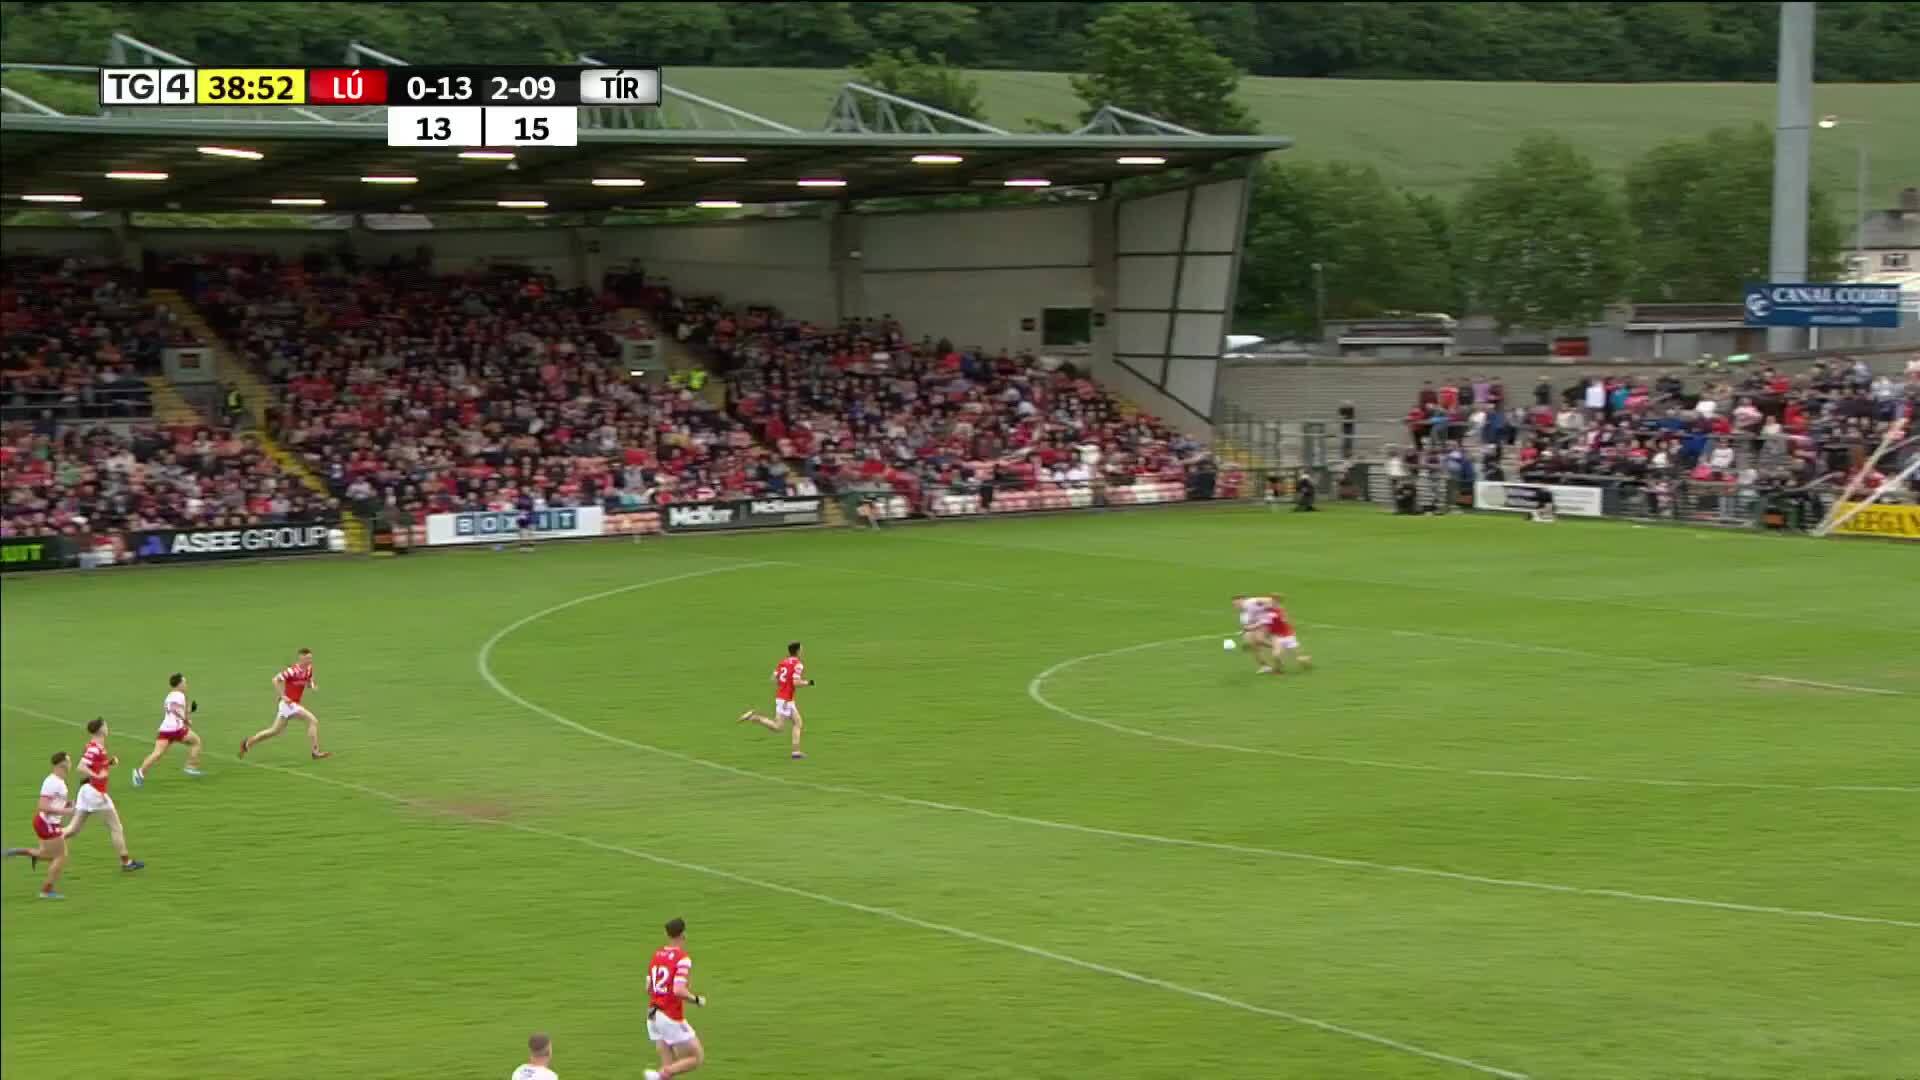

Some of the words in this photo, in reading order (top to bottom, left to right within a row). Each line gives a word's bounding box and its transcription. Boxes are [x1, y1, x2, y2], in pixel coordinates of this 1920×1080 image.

[171, 531, 240, 553] ASEE
[241, 526, 328, 550] GROUP
[779, 666, 789, 683] 2
[651, 965, 671, 993] 12
